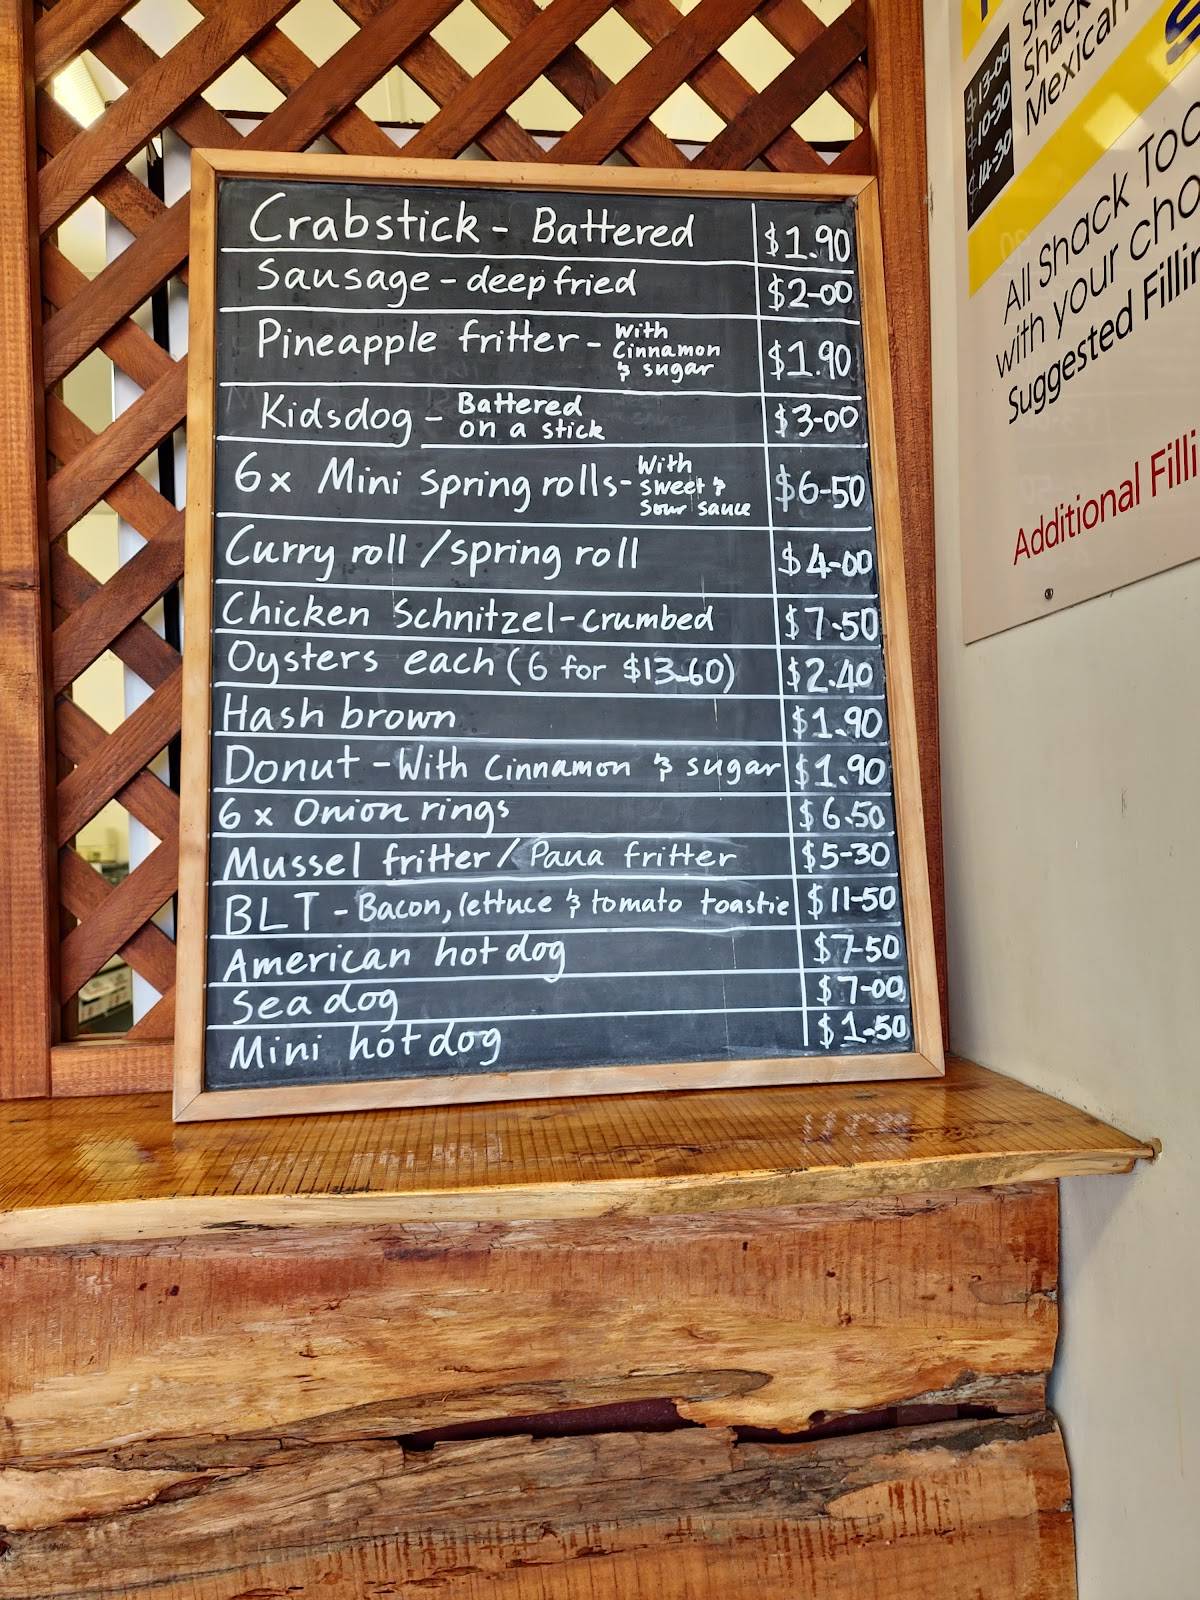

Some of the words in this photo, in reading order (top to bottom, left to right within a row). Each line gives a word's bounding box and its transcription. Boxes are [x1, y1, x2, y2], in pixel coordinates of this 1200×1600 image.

[249, 192, 480, 243] Crabstick
[532, 207, 695, 248] Battered
[1004, 262, 1031, 325] All
[1039, 172, 1130, 288] Shack
[257, 257, 430, 308] Sausage
[995, 313, 1045, 378] with
[1053, 243, 1118, 340] your
[258, 317, 436, 365] Pineapple
[458, 319, 579, 354] fritter
[1008, 288, 1132, 424] Suggested
[643, 362, 714, 383] sugar
[261, 392, 412, 447] Kidsdog
[458, 392, 582, 416] Battered
[459, 419, 496, 438] on
[510, 420, 527, 438] a
[543, 419, 605, 440] stick
[317, 457, 402, 494] Mini
[1014, 461, 1140, 565] Additional
[225, 524, 335, 582] Curry
[352, 533, 406, 564] roll
[576, 537, 638, 569] roll
[222, 591, 370, 627] Chicken
[227, 640, 378, 685] Oysters
[404, 647, 495, 676] each
[560, 654, 607, 681] for
[223, 692, 324, 732] Hash
[340, 695, 456, 730] brown
[225, 744, 360, 785] Donut
[484, 754, 631, 781] Cinnamon
[686, 757, 781, 785] sugar
[294, 798, 409, 826] Onion
[421, 798, 510, 838] rings
[223, 841, 361, 880] Mussel
[383, 843, 490, 876] fritter
[625, 841, 737, 868] fritter
[225, 892, 320, 935] BLT
[358, 892, 451, 924] Bacon,
[459, 889, 552, 917] lettuce
[592, 888, 682, 915] tomato
[700, 888, 789, 916] toastie
[222, 944, 411, 983] American
[434, 936, 498, 966] hot
[506, 934, 566, 983] dog
[232, 989, 312, 1025] Sea
[324, 983, 398, 1032] dog
[229, 1034, 323, 1069] Mini
[349, 1024, 421, 1061] hot
[428, 1020, 501, 1066] dog
